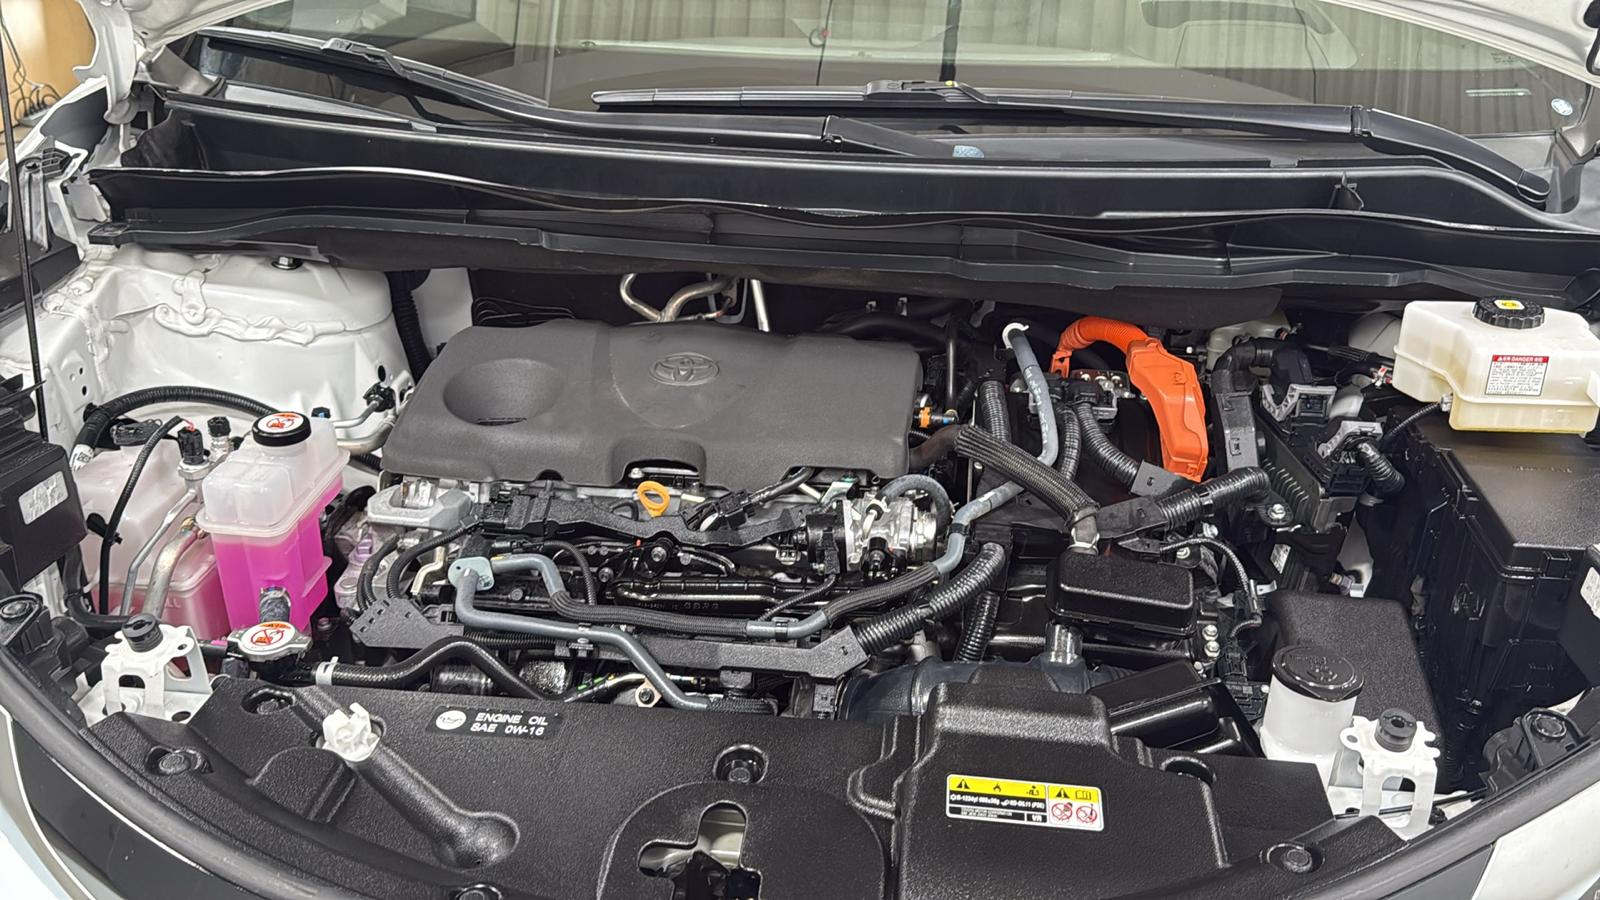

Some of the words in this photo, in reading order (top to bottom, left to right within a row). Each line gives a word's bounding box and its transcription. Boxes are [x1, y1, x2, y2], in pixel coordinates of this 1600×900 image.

[475, 713, 522, 723] ENGINE
[528, 716, 548, 725] OIL
[470, 723, 498, 732] SAE
[505, 725, 544, 736] 0W-16
